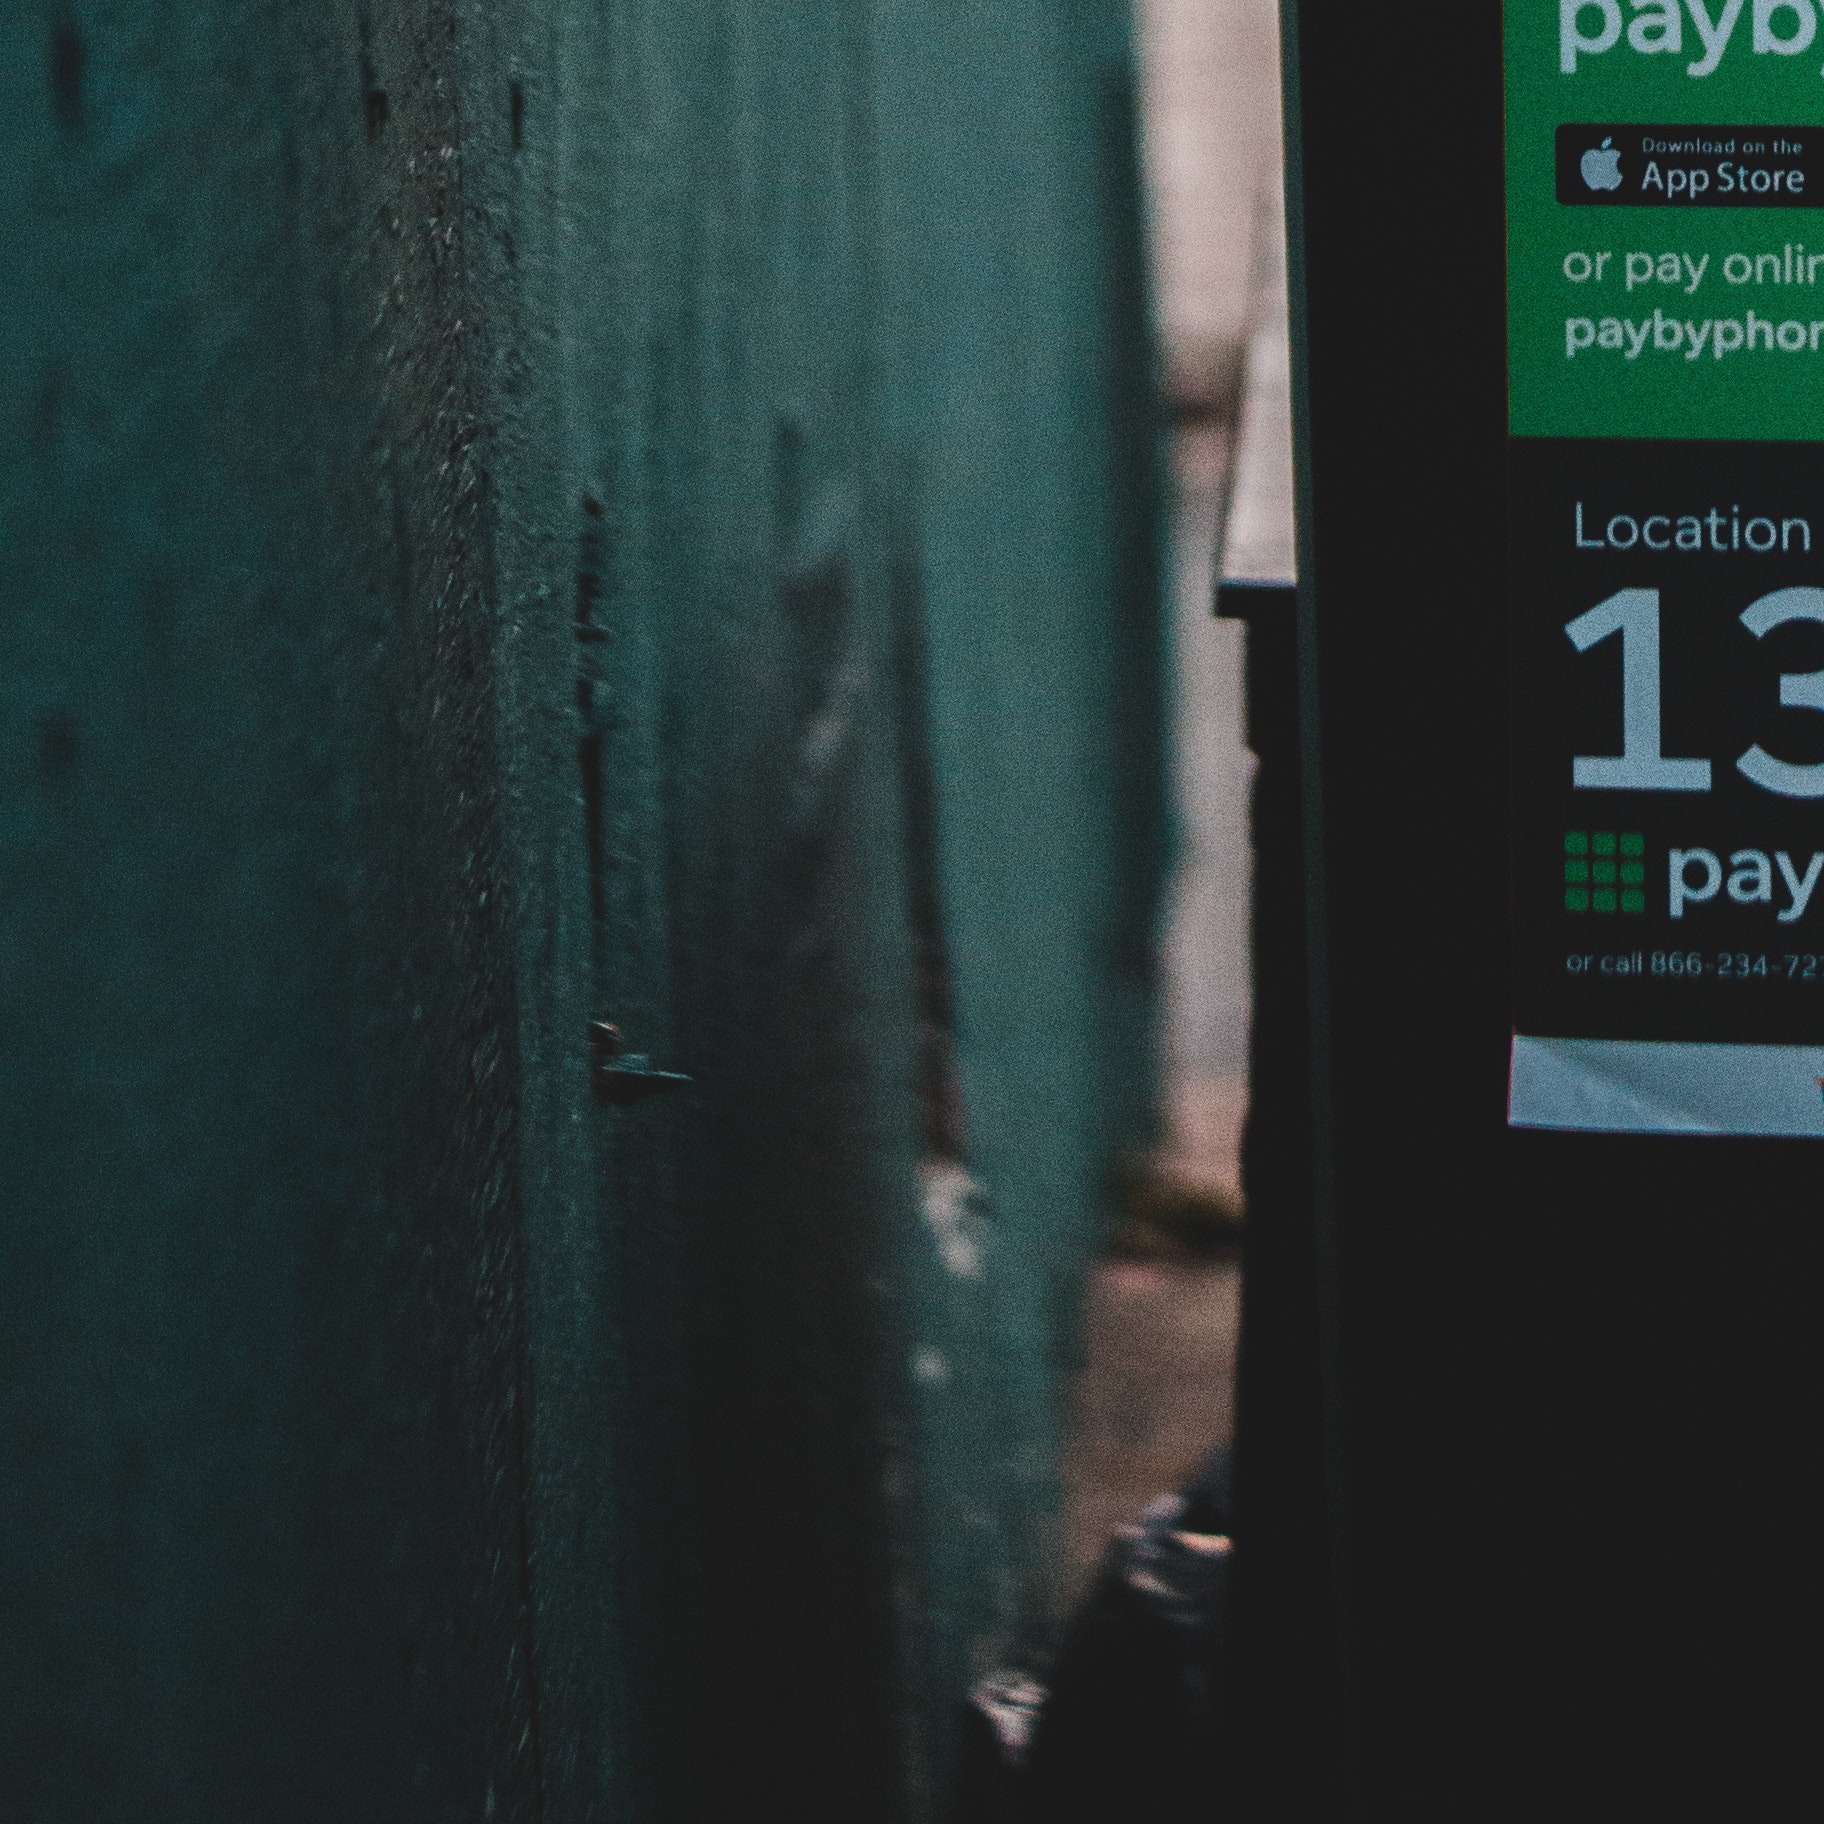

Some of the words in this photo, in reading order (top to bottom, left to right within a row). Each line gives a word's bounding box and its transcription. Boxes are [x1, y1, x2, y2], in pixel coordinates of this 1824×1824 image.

[1641, 137, 1736, 154] Download
[1742, 139, 1766, 154] on
[1772, 137, 1803, 155] the
[1641, 160, 1710, 199] App
[1717, 161, 1805, 193] Store
[1562, 251, 1612, 283] or
[1625, 251, 1710, 294] pay
[1575, 501, 1812, 554] Location
[1566, 953, 1594, 973] or
[1600, 951, 1643, 975] call
